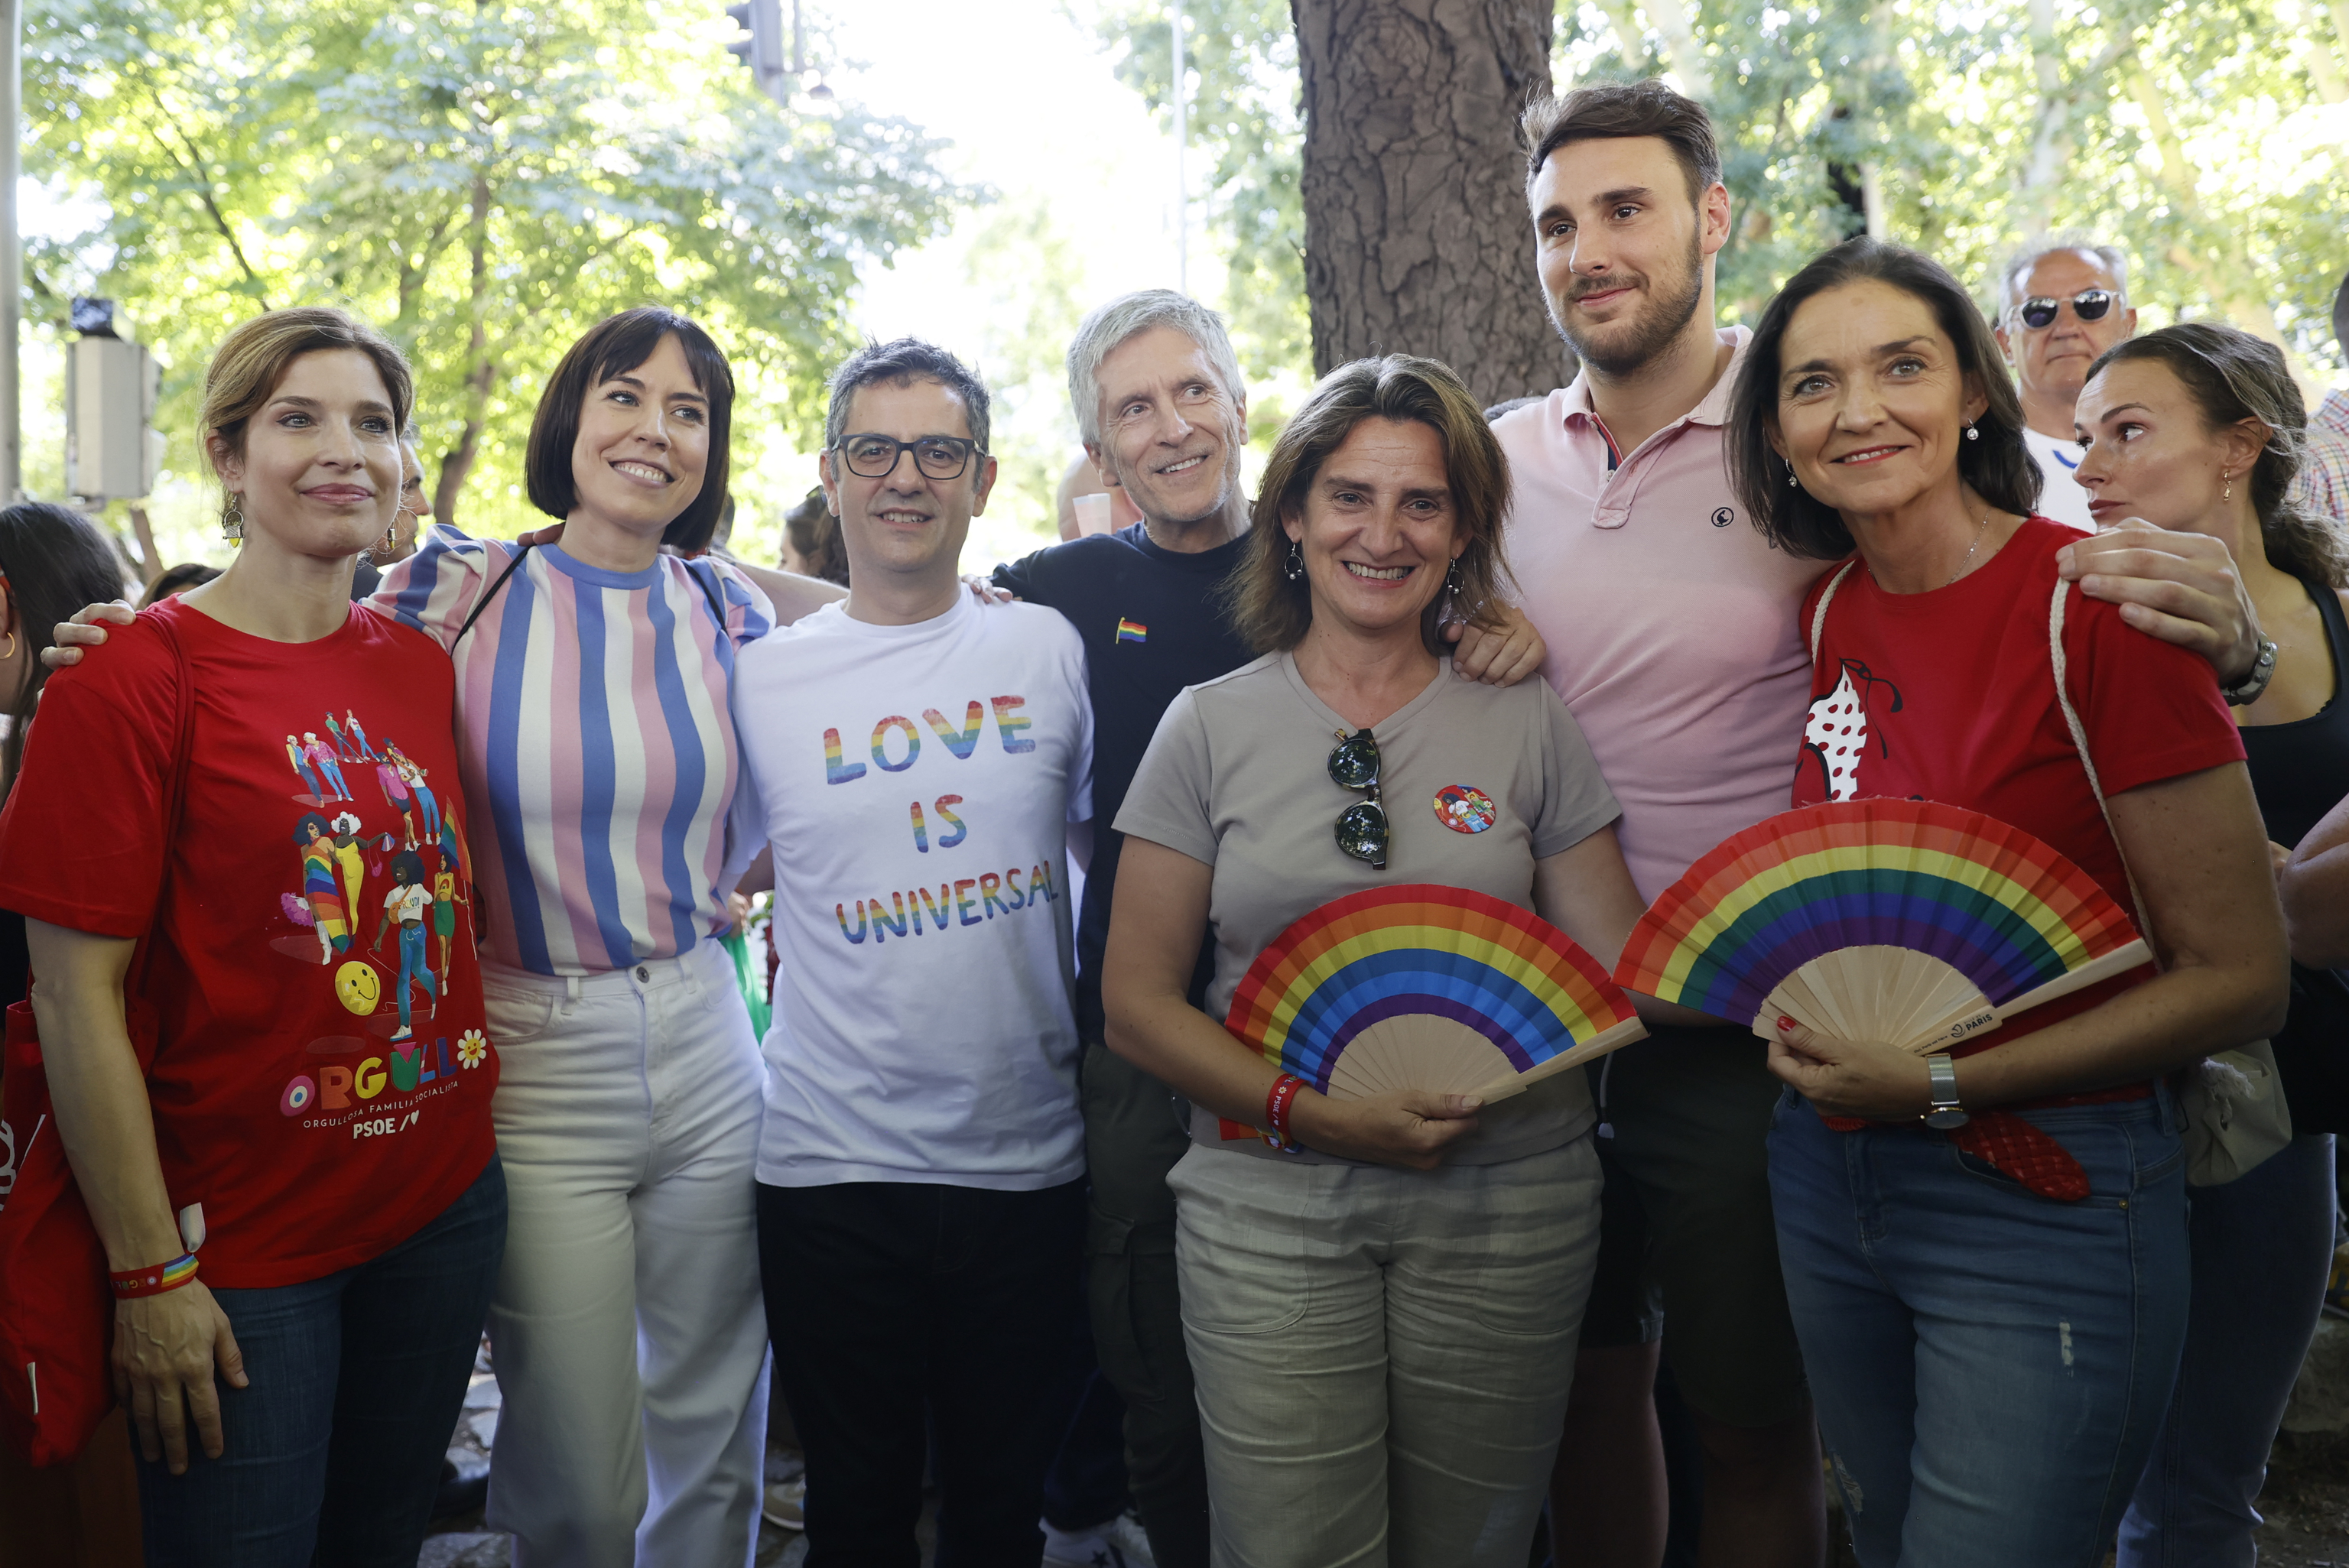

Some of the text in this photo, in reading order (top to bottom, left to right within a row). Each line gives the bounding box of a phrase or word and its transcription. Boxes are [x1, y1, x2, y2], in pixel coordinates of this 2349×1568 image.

[824, 695, 1035, 784] LOVE
[910, 794, 967, 852] IS
[398, 897, 420, 909] PROUD!
[836, 860, 1058, 944] UNIVERSAL
[1965, 1014, 1993, 1031] PARIS
[304, 1080, 458, 1128] ORGULLOSA FAMILIA SOCIALISTA
[1272, 1096, 1282, 1113] PSOE
[353, 1117, 396, 1139] PSOE
